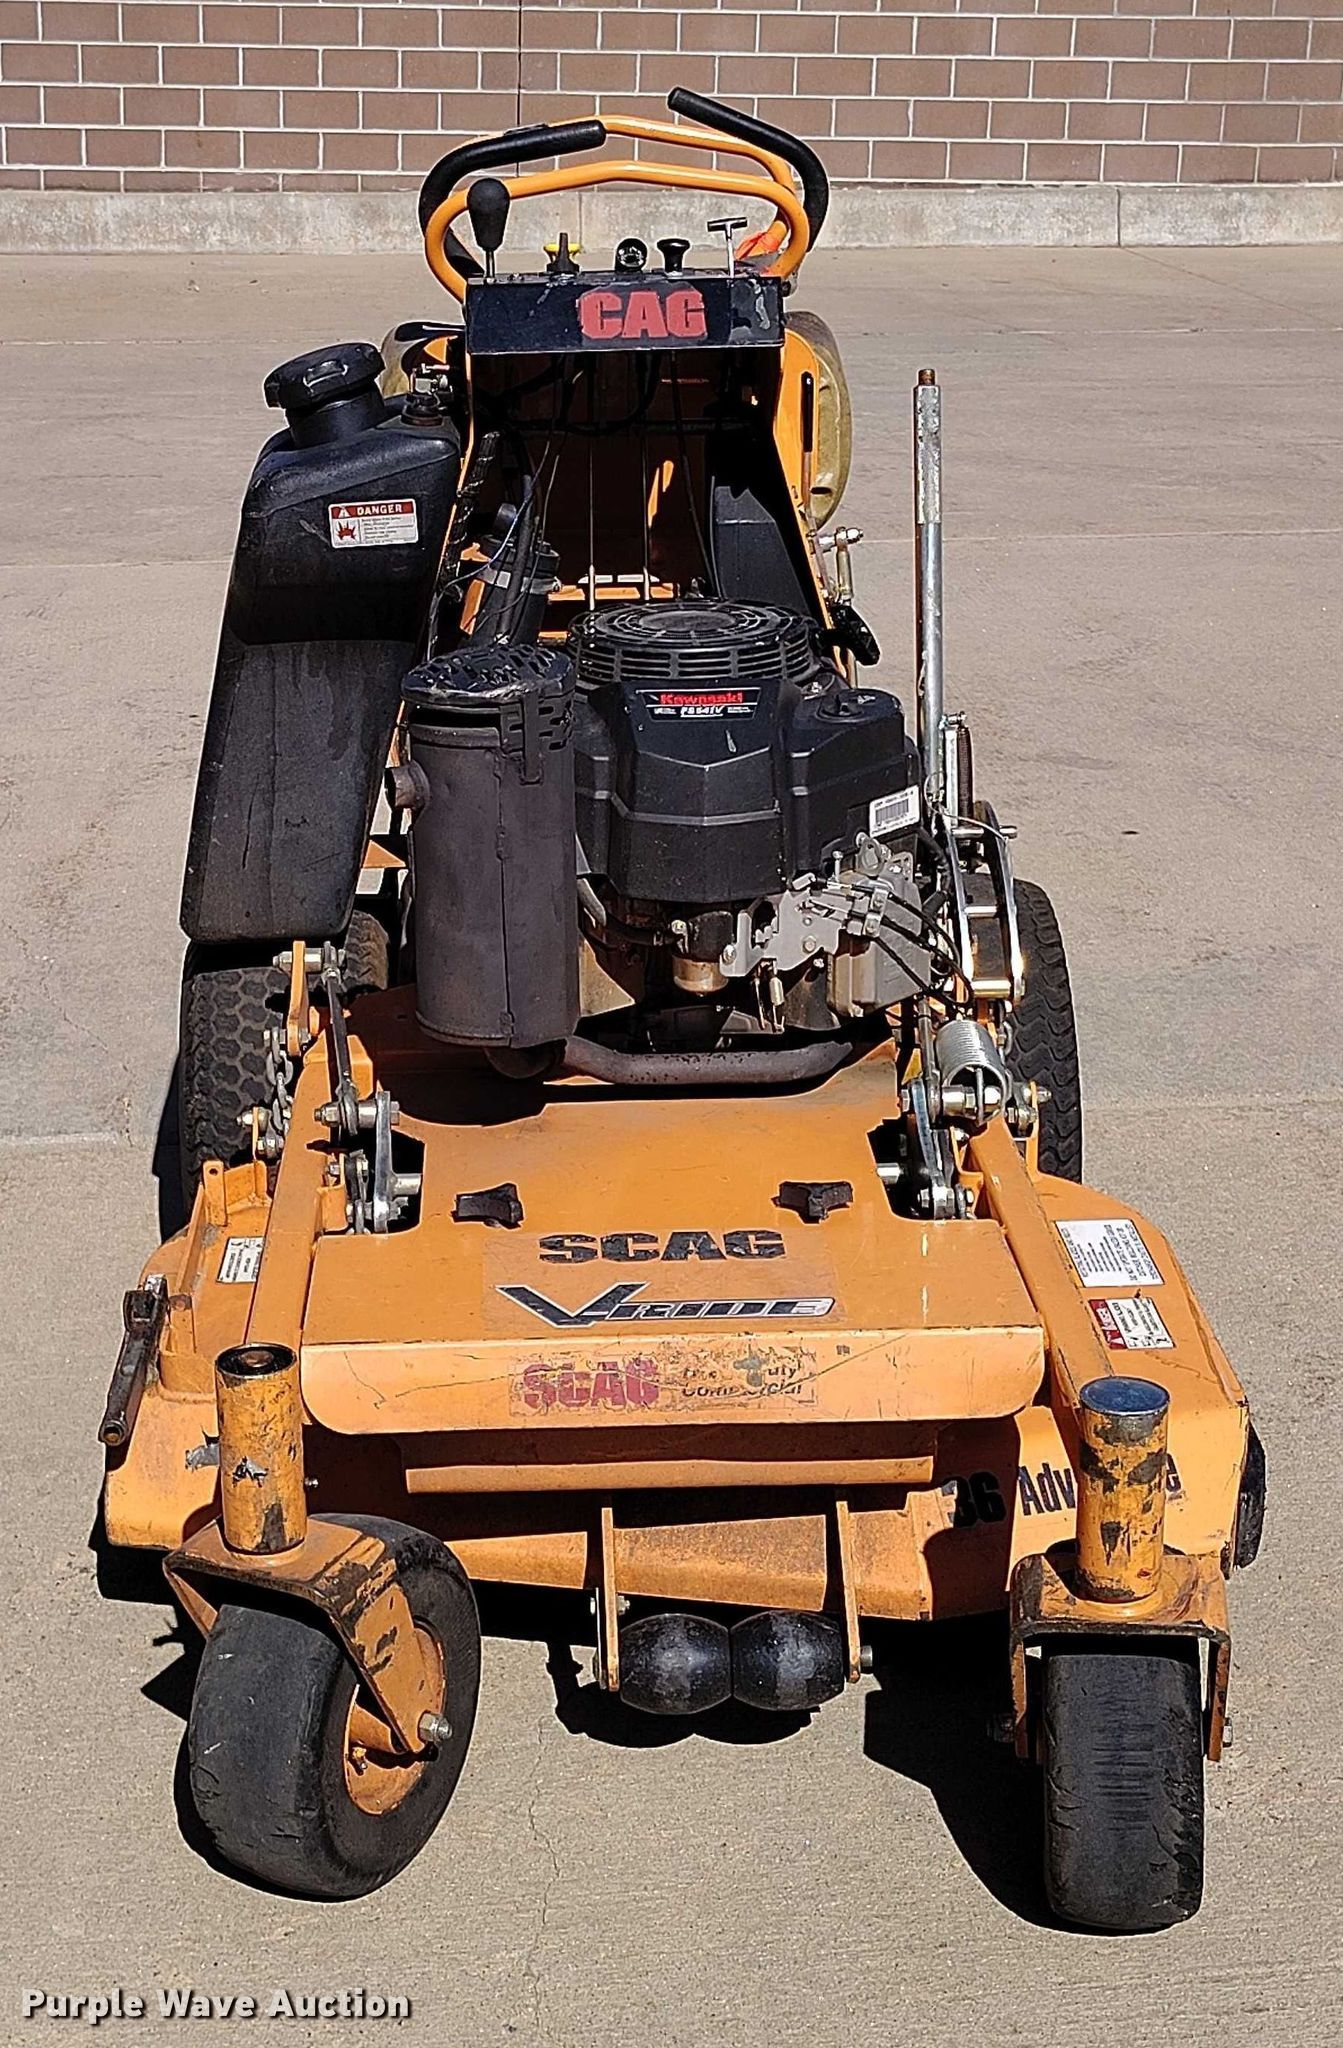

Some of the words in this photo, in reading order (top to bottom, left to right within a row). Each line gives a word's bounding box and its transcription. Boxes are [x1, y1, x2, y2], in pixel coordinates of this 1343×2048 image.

[580, 291, 707, 339] CAG
[357, 503, 402, 516] DANGER
[660, 692, 743, 704] Kawasaki
[539, 1230, 785, 1263] SCAG
[523, 1359, 660, 1409] SCAG
[942, 1471, 1007, 1529] 36
